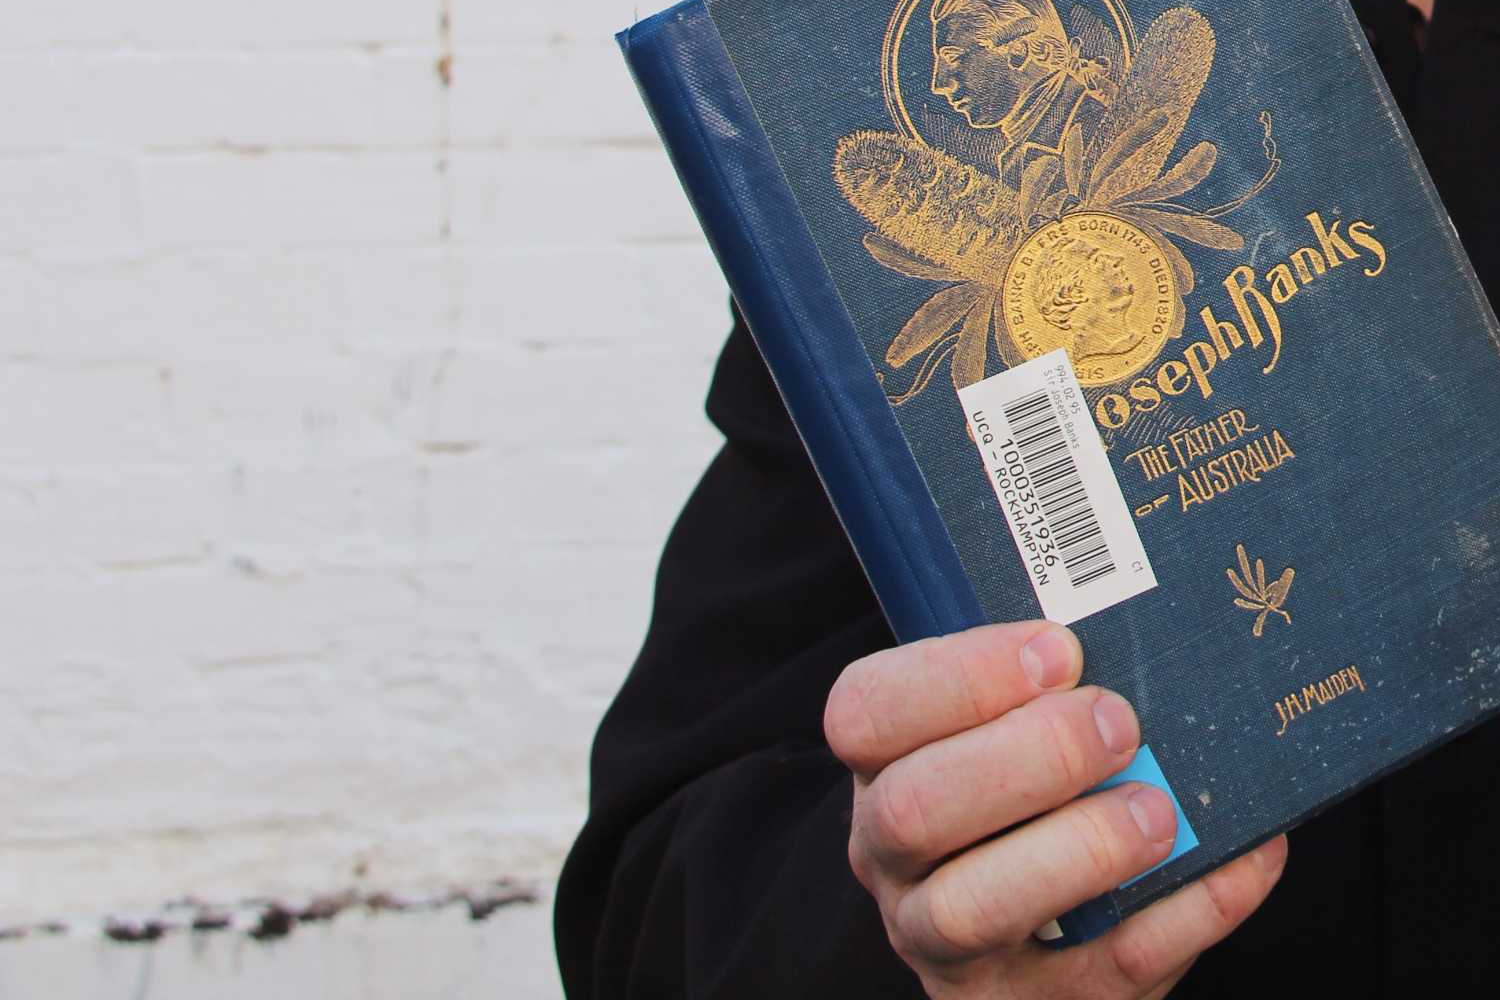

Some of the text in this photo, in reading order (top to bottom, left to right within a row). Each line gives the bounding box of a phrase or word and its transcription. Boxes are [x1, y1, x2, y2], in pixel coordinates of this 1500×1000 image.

[1078, 219, 1121, 236] BORN
[1011, 272, 1026, 326] BANKS
[1149, 258, 1169, 294] DIED
[1096, 210, 1387, 429] oseph Banks
[1152, 300, 1169, 335] 1820
[1064, 422, 1080, 449] Banks
[1123, 408, 1259, 481] THE FATHER
[972, 410, 994, 445] UCQ
[995, 468, 1050, 586] ROCKHAMPTON
[999, 438, 1059, 567] 1000351936
[1135, 430, 1297, 518] OF AUSTRALIA
